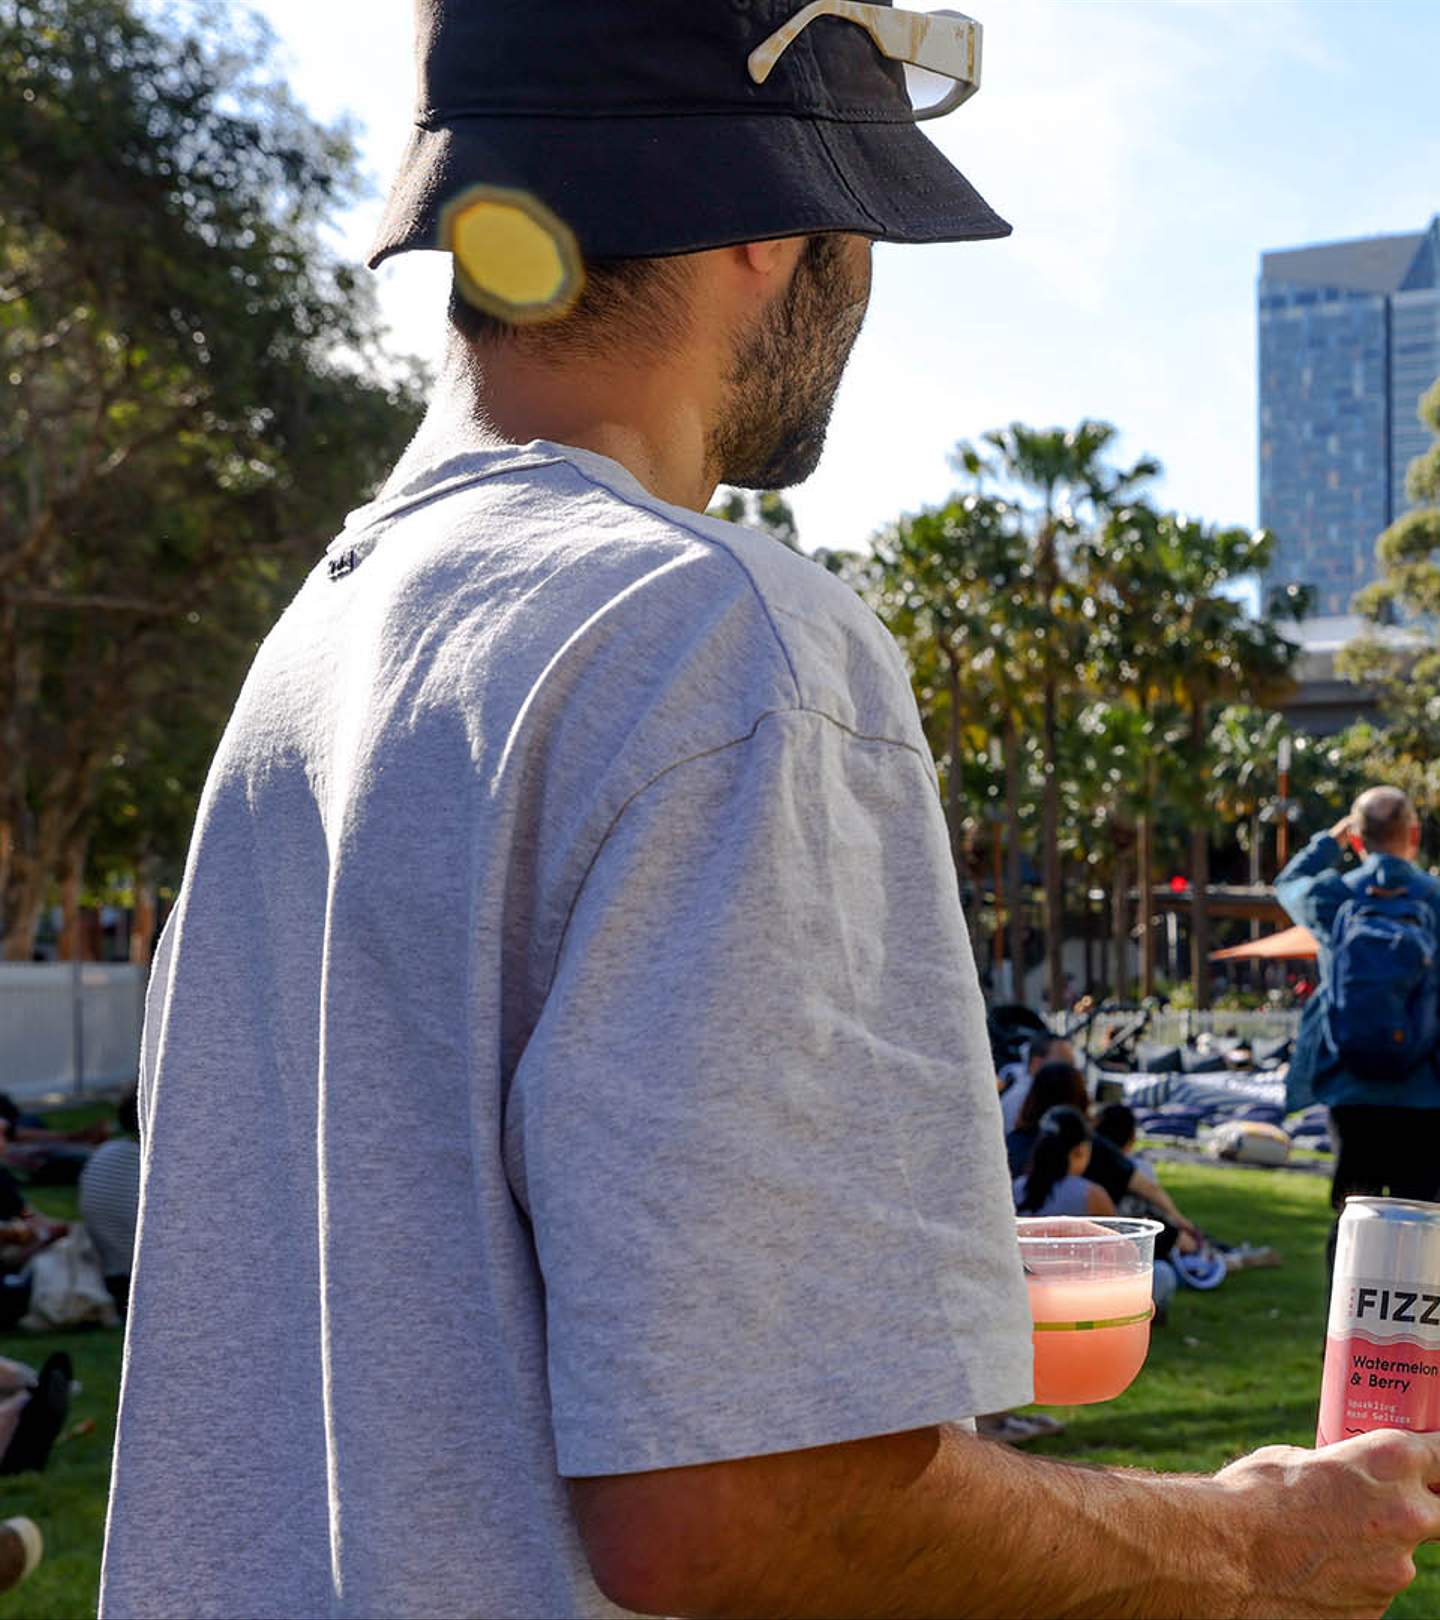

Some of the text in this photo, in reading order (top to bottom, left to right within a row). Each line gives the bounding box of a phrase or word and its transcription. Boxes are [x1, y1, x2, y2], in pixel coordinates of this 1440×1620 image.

[1353, 1355, 1439, 1377] Watermelon
[1350, 1372, 1411, 1393] & Berry
